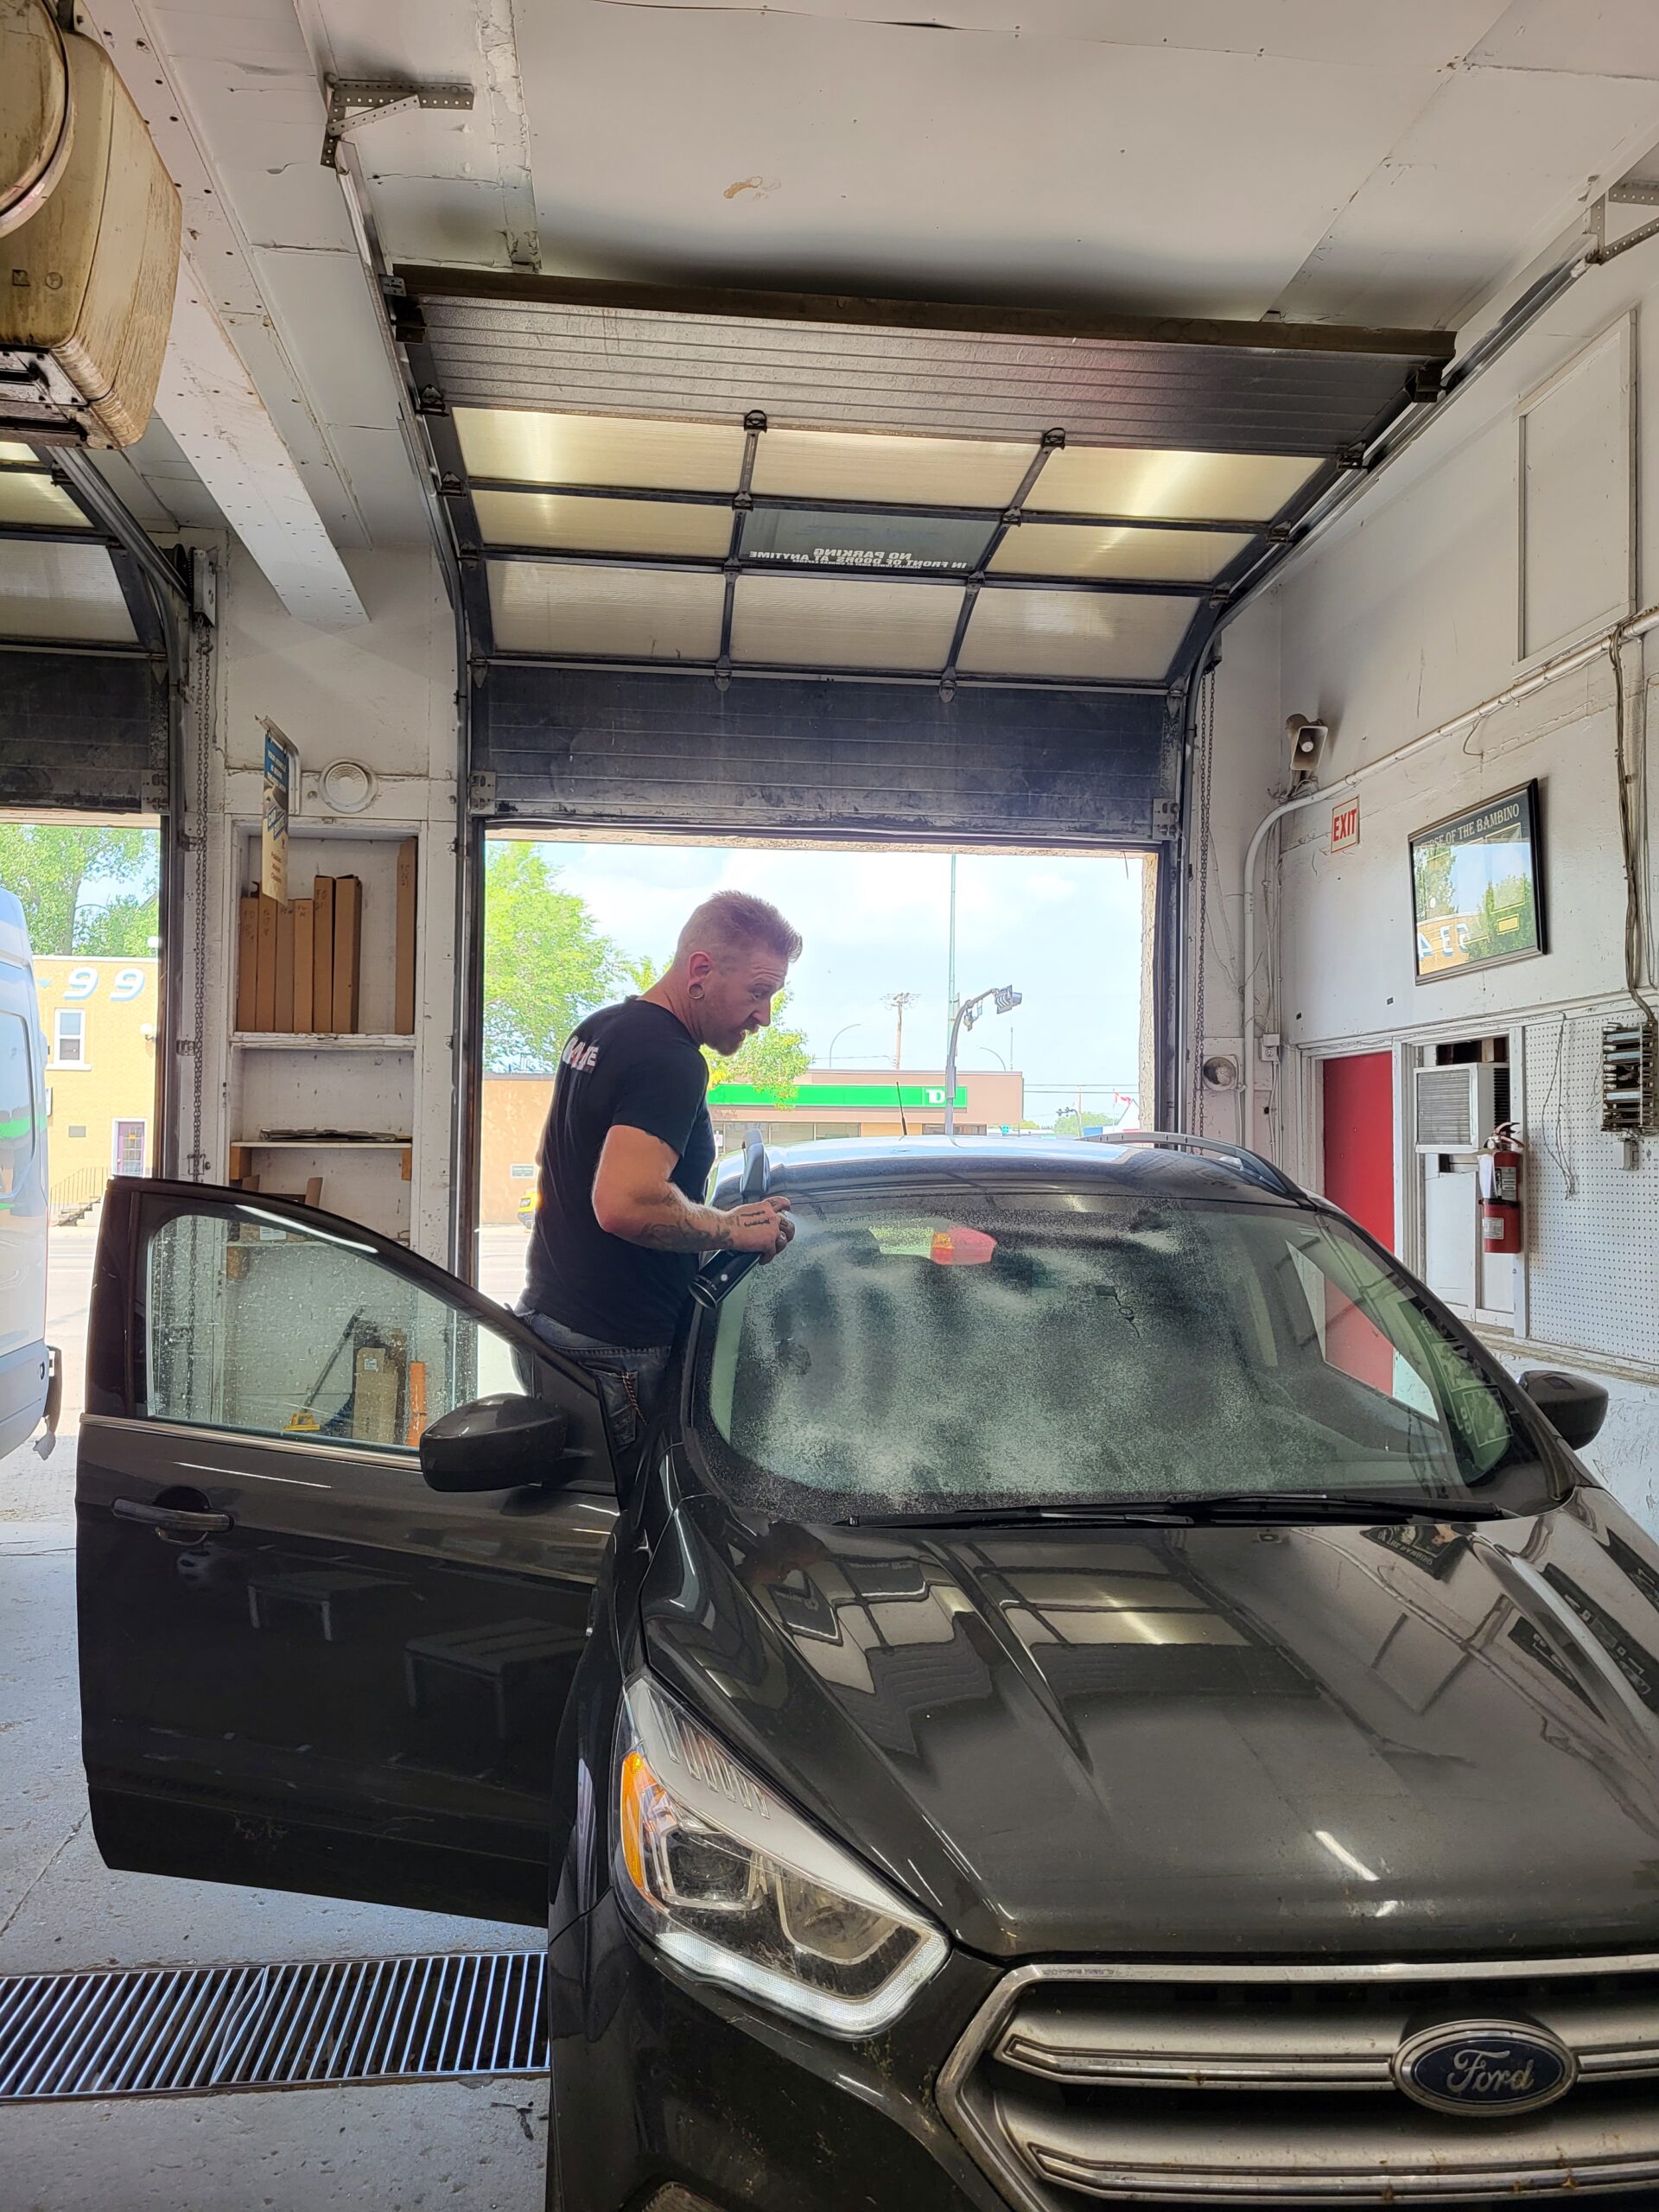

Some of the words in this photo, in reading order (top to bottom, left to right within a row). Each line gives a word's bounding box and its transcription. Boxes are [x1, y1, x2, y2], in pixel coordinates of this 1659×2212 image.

[1333, 808, 1357, 842] EXIT
[1446, 829, 1457, 844] OF
[1458, 822, 1476, 840] THE
[1476, 803, 1520, 833] BAMBINO
[925, 1089, 945, 1104] TD
[1446, 2049, 1535, 2093] Ford
